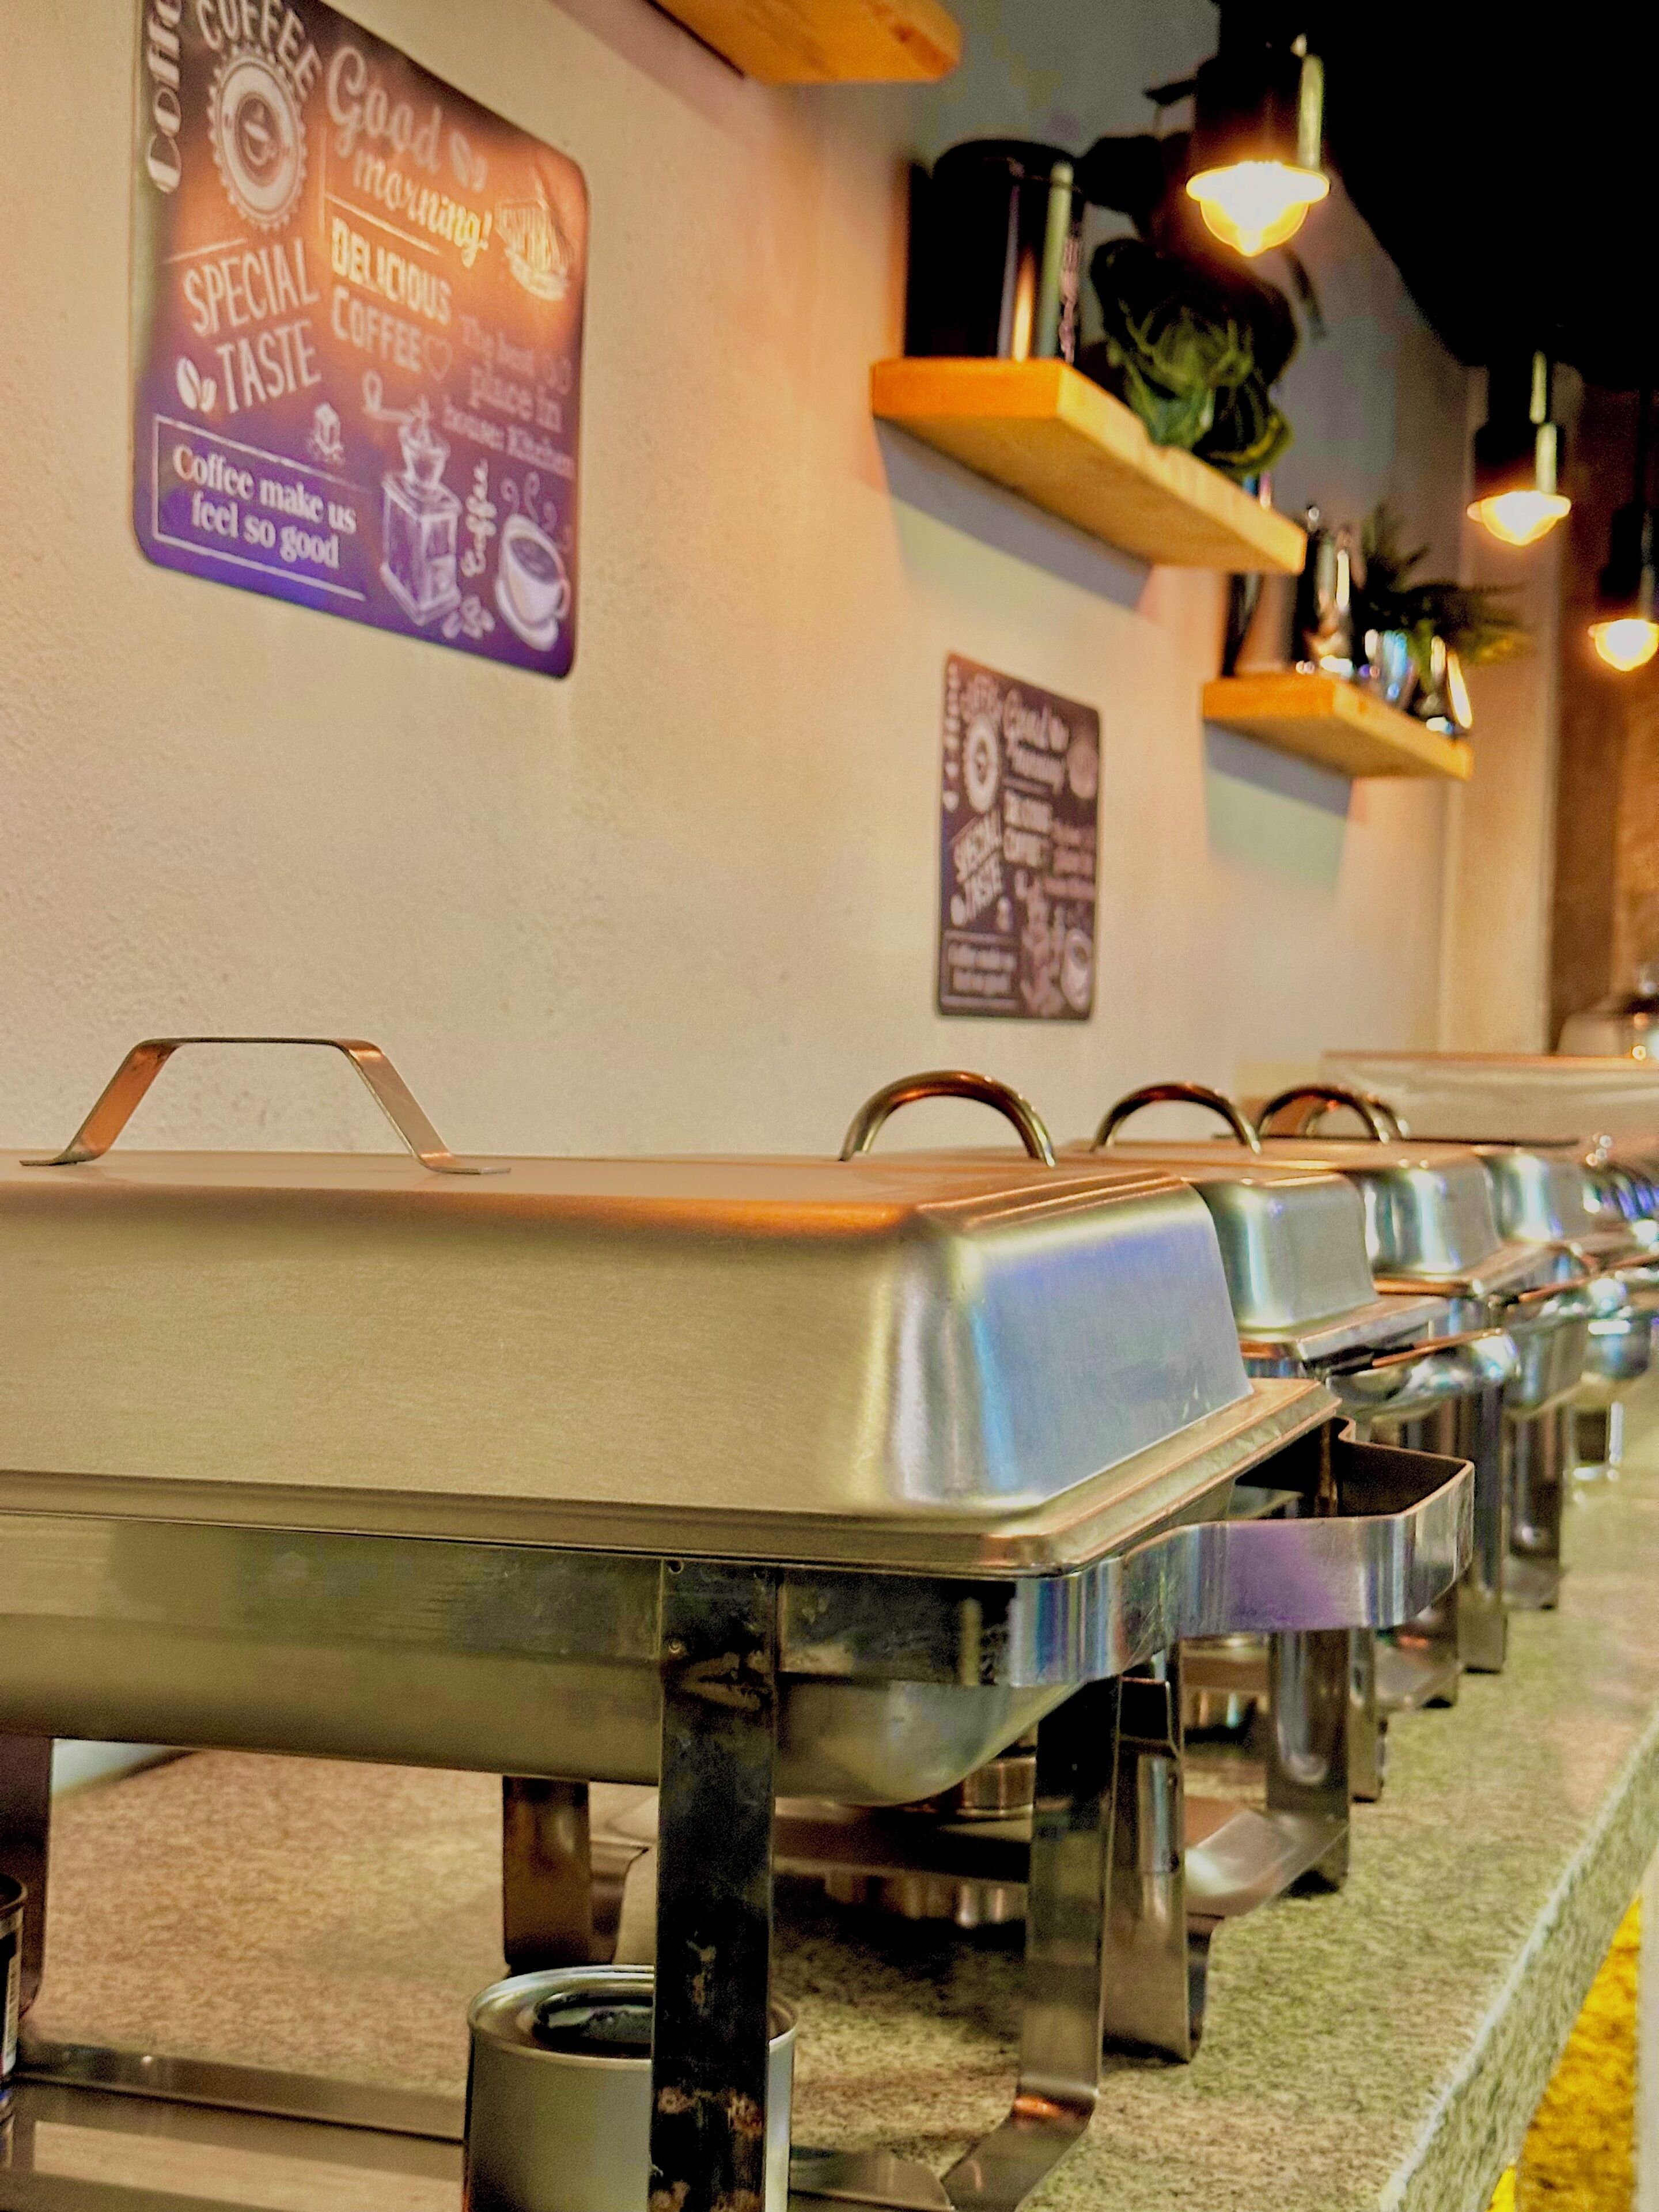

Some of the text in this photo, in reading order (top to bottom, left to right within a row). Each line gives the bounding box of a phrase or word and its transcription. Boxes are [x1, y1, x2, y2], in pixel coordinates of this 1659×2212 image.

[196, 0, 323, 100] COFFEE
[327, 45, 443, 174] Good
[352, 149, 493, 268] morning!
[184, 237, 320, 336] SPECIAL
[332, 215, 452, 326] DELICIOUS
[216, 319, 321, 414] TASTE
[332, 285, 422, 373] COFFEE
[173, 445, 357, 535] Coffee make us
[191, 490, 340, 569] feel so good
